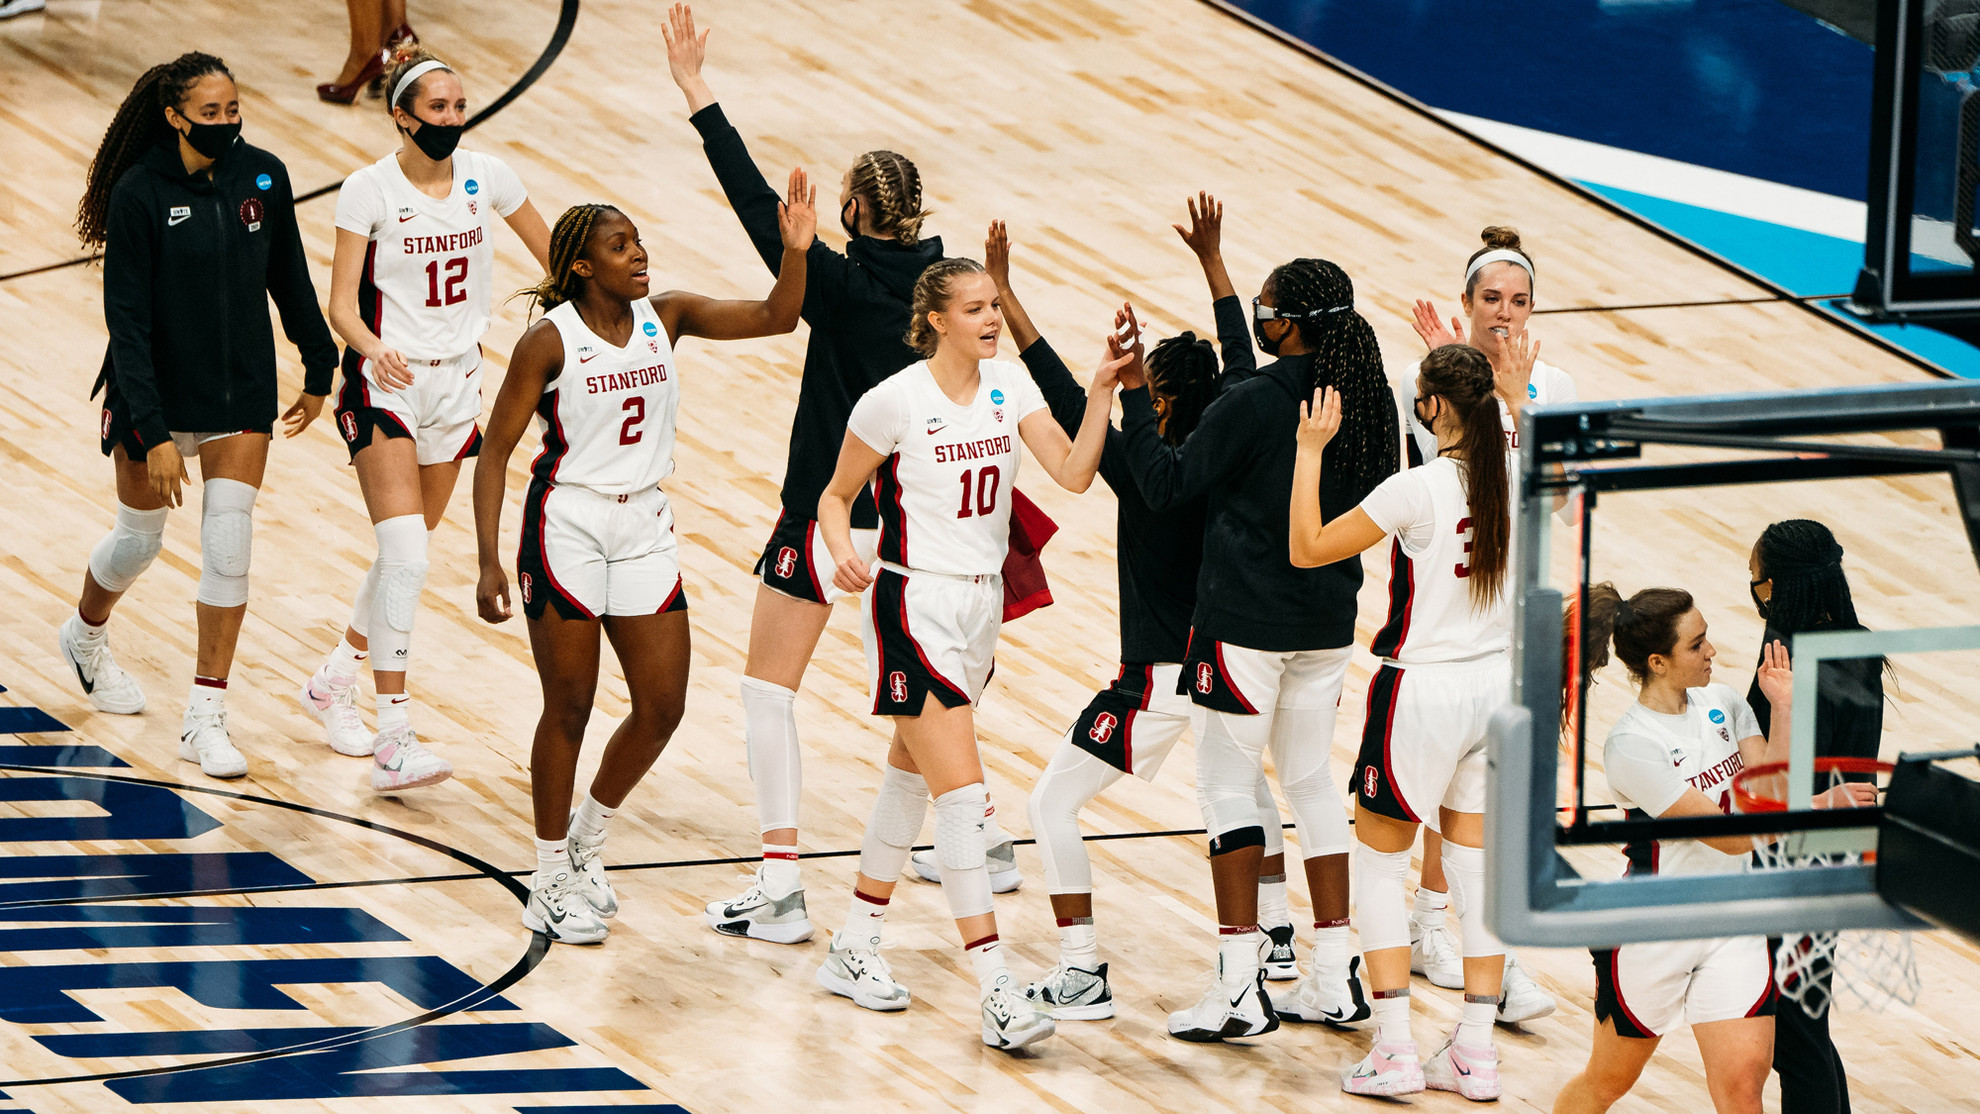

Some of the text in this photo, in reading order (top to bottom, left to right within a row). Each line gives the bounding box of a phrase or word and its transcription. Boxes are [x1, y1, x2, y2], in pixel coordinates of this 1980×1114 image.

[403, 226, 483, 254] STANFORD
[425, 256, 469, 307] 12
[586, 364, 668, 394] STANFORD
[619, 395, 646, 446] 2
[934, 435, 1011, 463] STANFORD
[957, 464, 1000, 519] 10
[1454, 516, 1476, 578] 3
[1685, 751, 1745, 792] TANFORD
